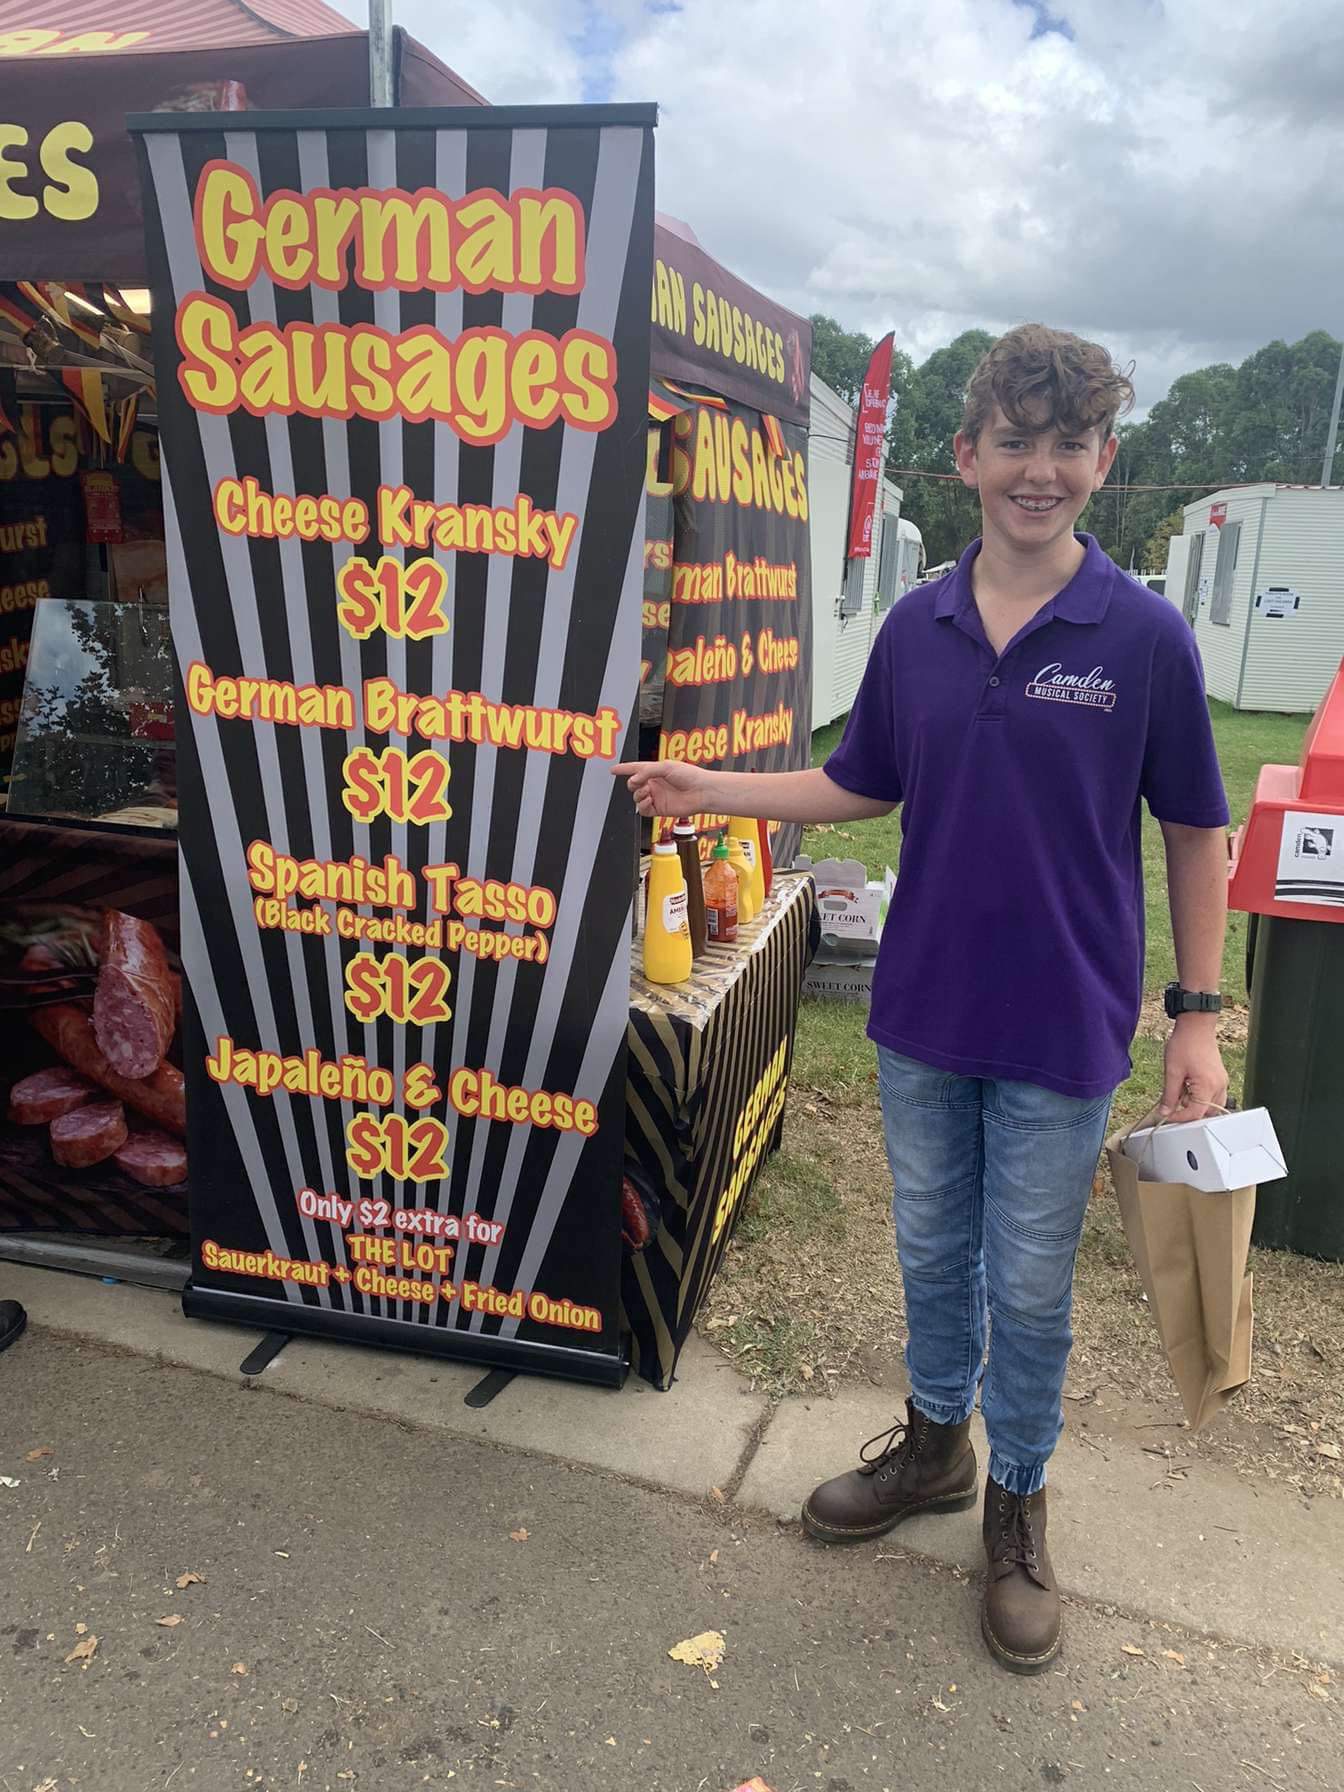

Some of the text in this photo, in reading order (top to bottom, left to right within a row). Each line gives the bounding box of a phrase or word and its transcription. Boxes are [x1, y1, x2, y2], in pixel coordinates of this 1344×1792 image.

[196, 161, 583, 292] German
[651, 259, 785, 384] AN SAUSAGES
[177, 293, 615, 443] Sausages
[214, 477, 578, 570] Cheese Kransky
[338, 556, 448, 639] $12
[186, 660, 620, 759] German Brattwurst
[1034, 662, 1116, 690] Camden
[1034, 686, 1108, 704] MUSICAL SOCIETY
[732, 700, 793, 757] Kransky
[342, 746, 452, 825] $12
[247, 839, 556, 928] Spanish Tasso
[254, 896, 548, 964] (Black Cracked Pepper)
[345, 952, 452, 1026] $12
[206, 1037, 599, 1136] Japaleño & Cheese
[346, 1112, 450, 1183] $12
[299, 1188, 503, 1245] Only $2 extra for
[346, 1234, 453, 1275] THE LOT
[202, 1240, 329, 1287] Sauerkraut
[355, 1266, 434, 1304] Cheese
[462, 1284, 523, 1319] Fried
[528, 1294, 602, 1333] Onion
